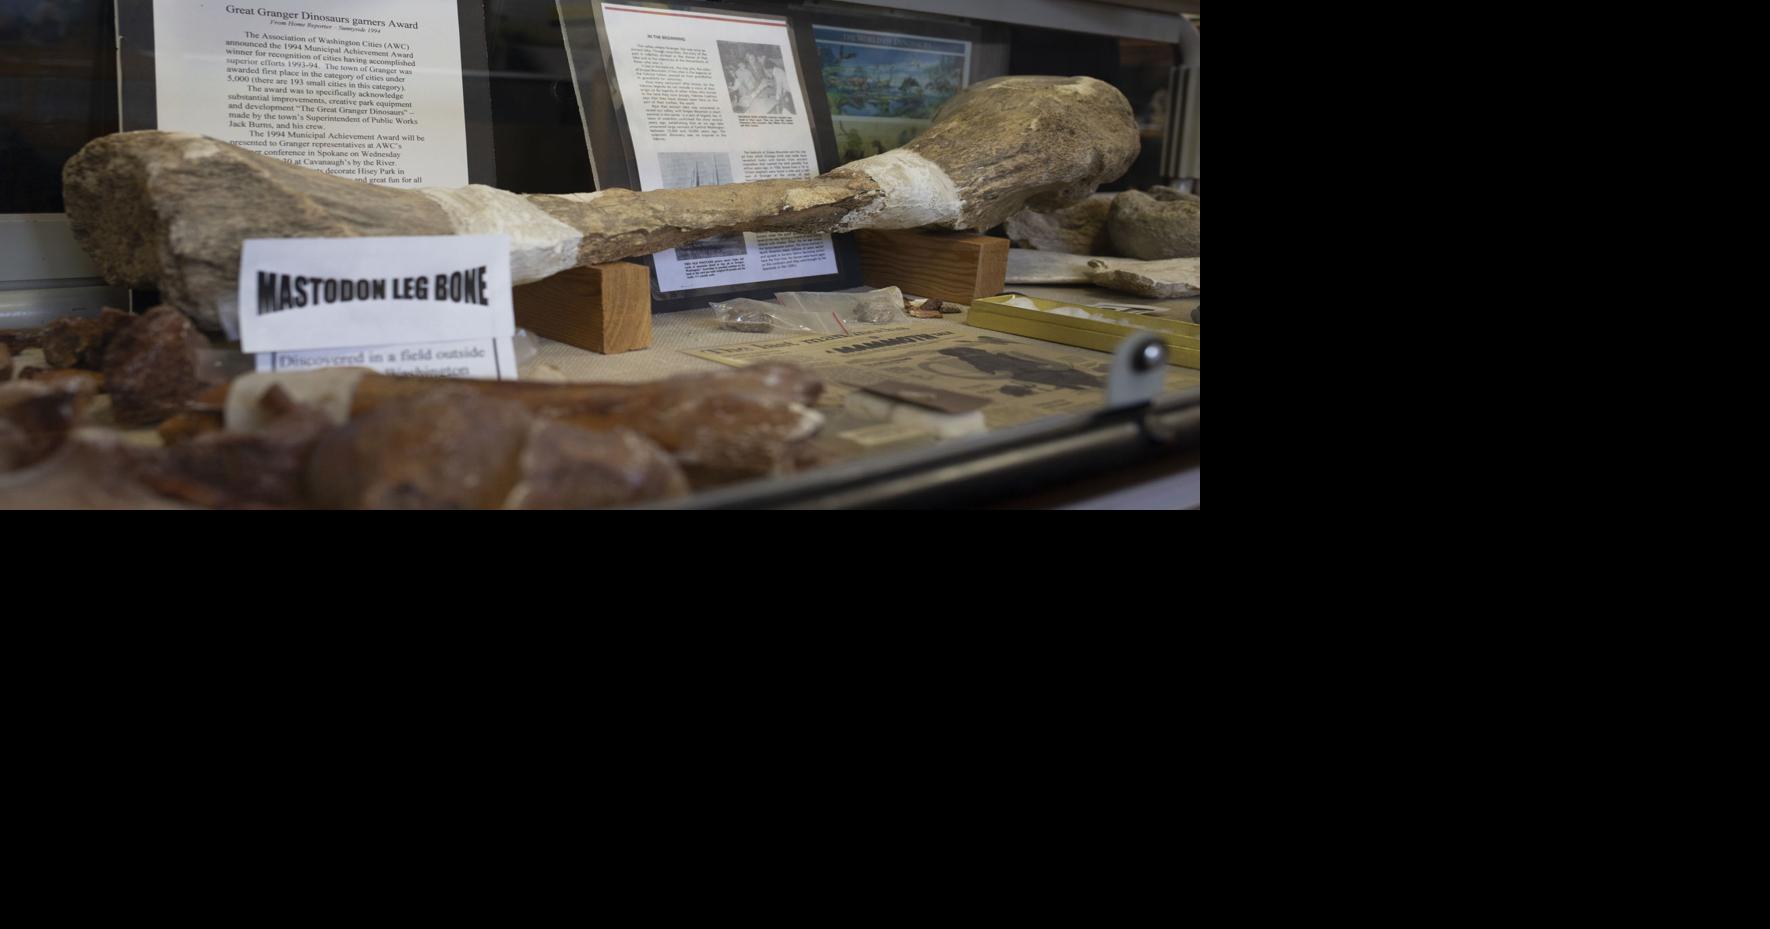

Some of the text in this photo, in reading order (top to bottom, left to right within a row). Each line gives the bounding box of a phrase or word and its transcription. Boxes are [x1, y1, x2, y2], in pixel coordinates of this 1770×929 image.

[226, 5, 418, 29] Great Granger Dinosaurs garners Award
[262, 33, 306, 42] Association
[318, 37, 360, 46] Washington
[226, 40, 268, 48] announced
[304, 45, 341, 53] Municipal
[344, 48, 388, 57] Achievement
[268, 52, 310, 60] recognition
[344, 56, 367, 64] having
[324, 72, 354, 80] category
[316, 89, 356, 97] specifically
[358, 92, 404, 100] acknowledge
[245, 103, 294, 112] development
[306, 114, 360, 123] Superintendent
[288, 131, 326, 139] Municipal
[361, 151, 400, 159] Wednesday
[256, 265, 488, 316] MASTODON LEG BONE
[279, 347, 485, 368] Discovered in a field outside
